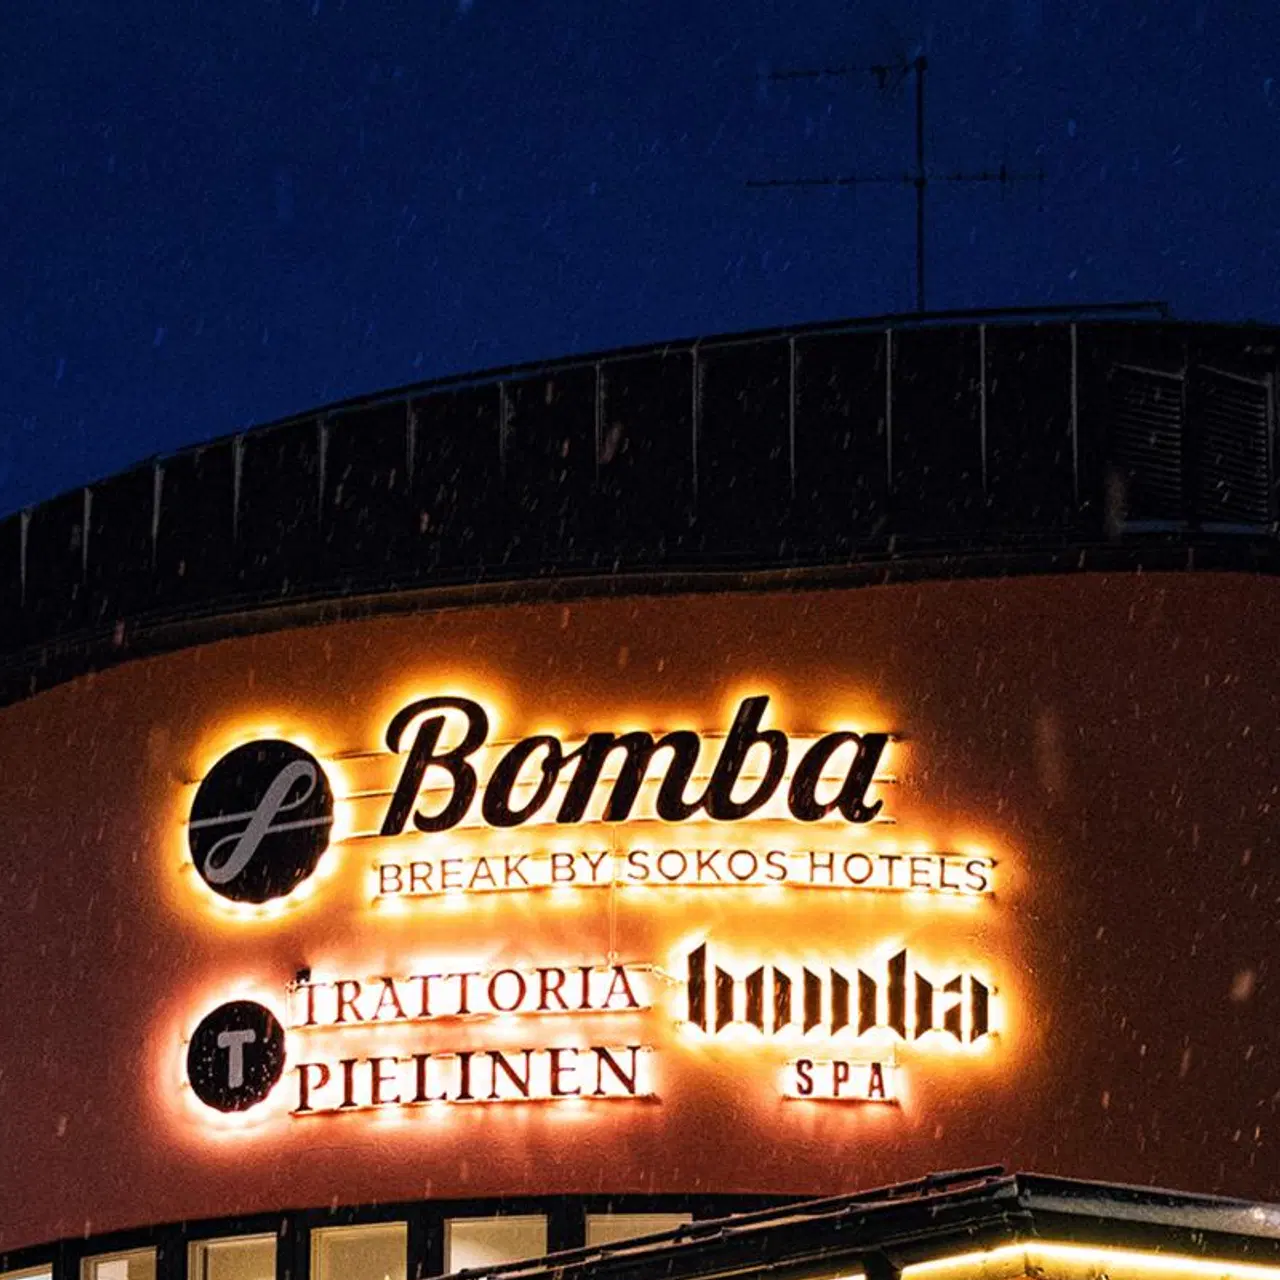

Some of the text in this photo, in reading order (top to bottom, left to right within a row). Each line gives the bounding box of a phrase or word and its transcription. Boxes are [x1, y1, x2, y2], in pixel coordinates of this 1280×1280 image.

[380, 695, 891, 836] Bomba
[379, 850, 987, 893] BREAK BY SOKOS HOTELS
[298, 965, 639, 1025] TRATTORIA
[688, 942, 988, 1043] bomba
[218, 1029, 256, 1088] T
[294, 1046, 642, 1112] PIELINEN
[796, 1059, 885, 1098] SPA
